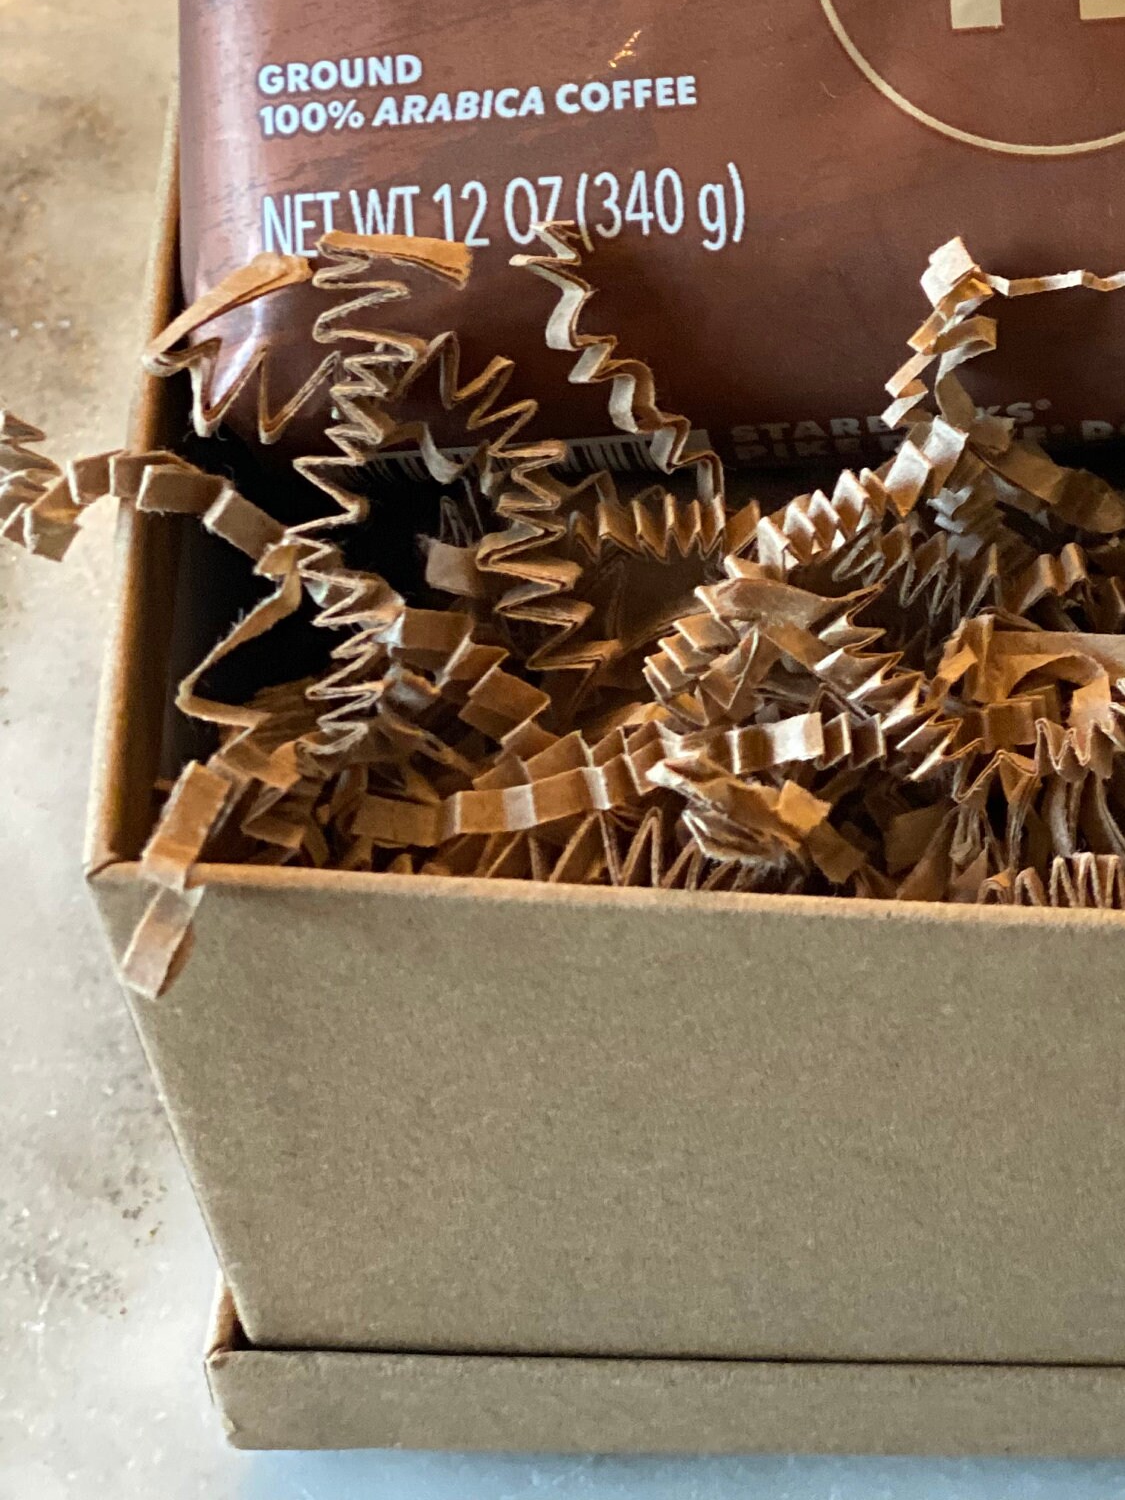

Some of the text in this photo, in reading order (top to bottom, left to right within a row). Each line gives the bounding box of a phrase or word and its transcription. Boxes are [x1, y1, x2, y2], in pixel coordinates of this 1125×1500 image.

[257, 54, 422, 95] GROUND
[259, 75, 697, 135] 100% ARABICA COFFEE
[262, 190, 340, 257] NET
[350, 185, 420, 236] WT
[432, 181, 490, 246] 12
[576, 167, 685, 251] (340
[699, 162, 745, 252] g)
